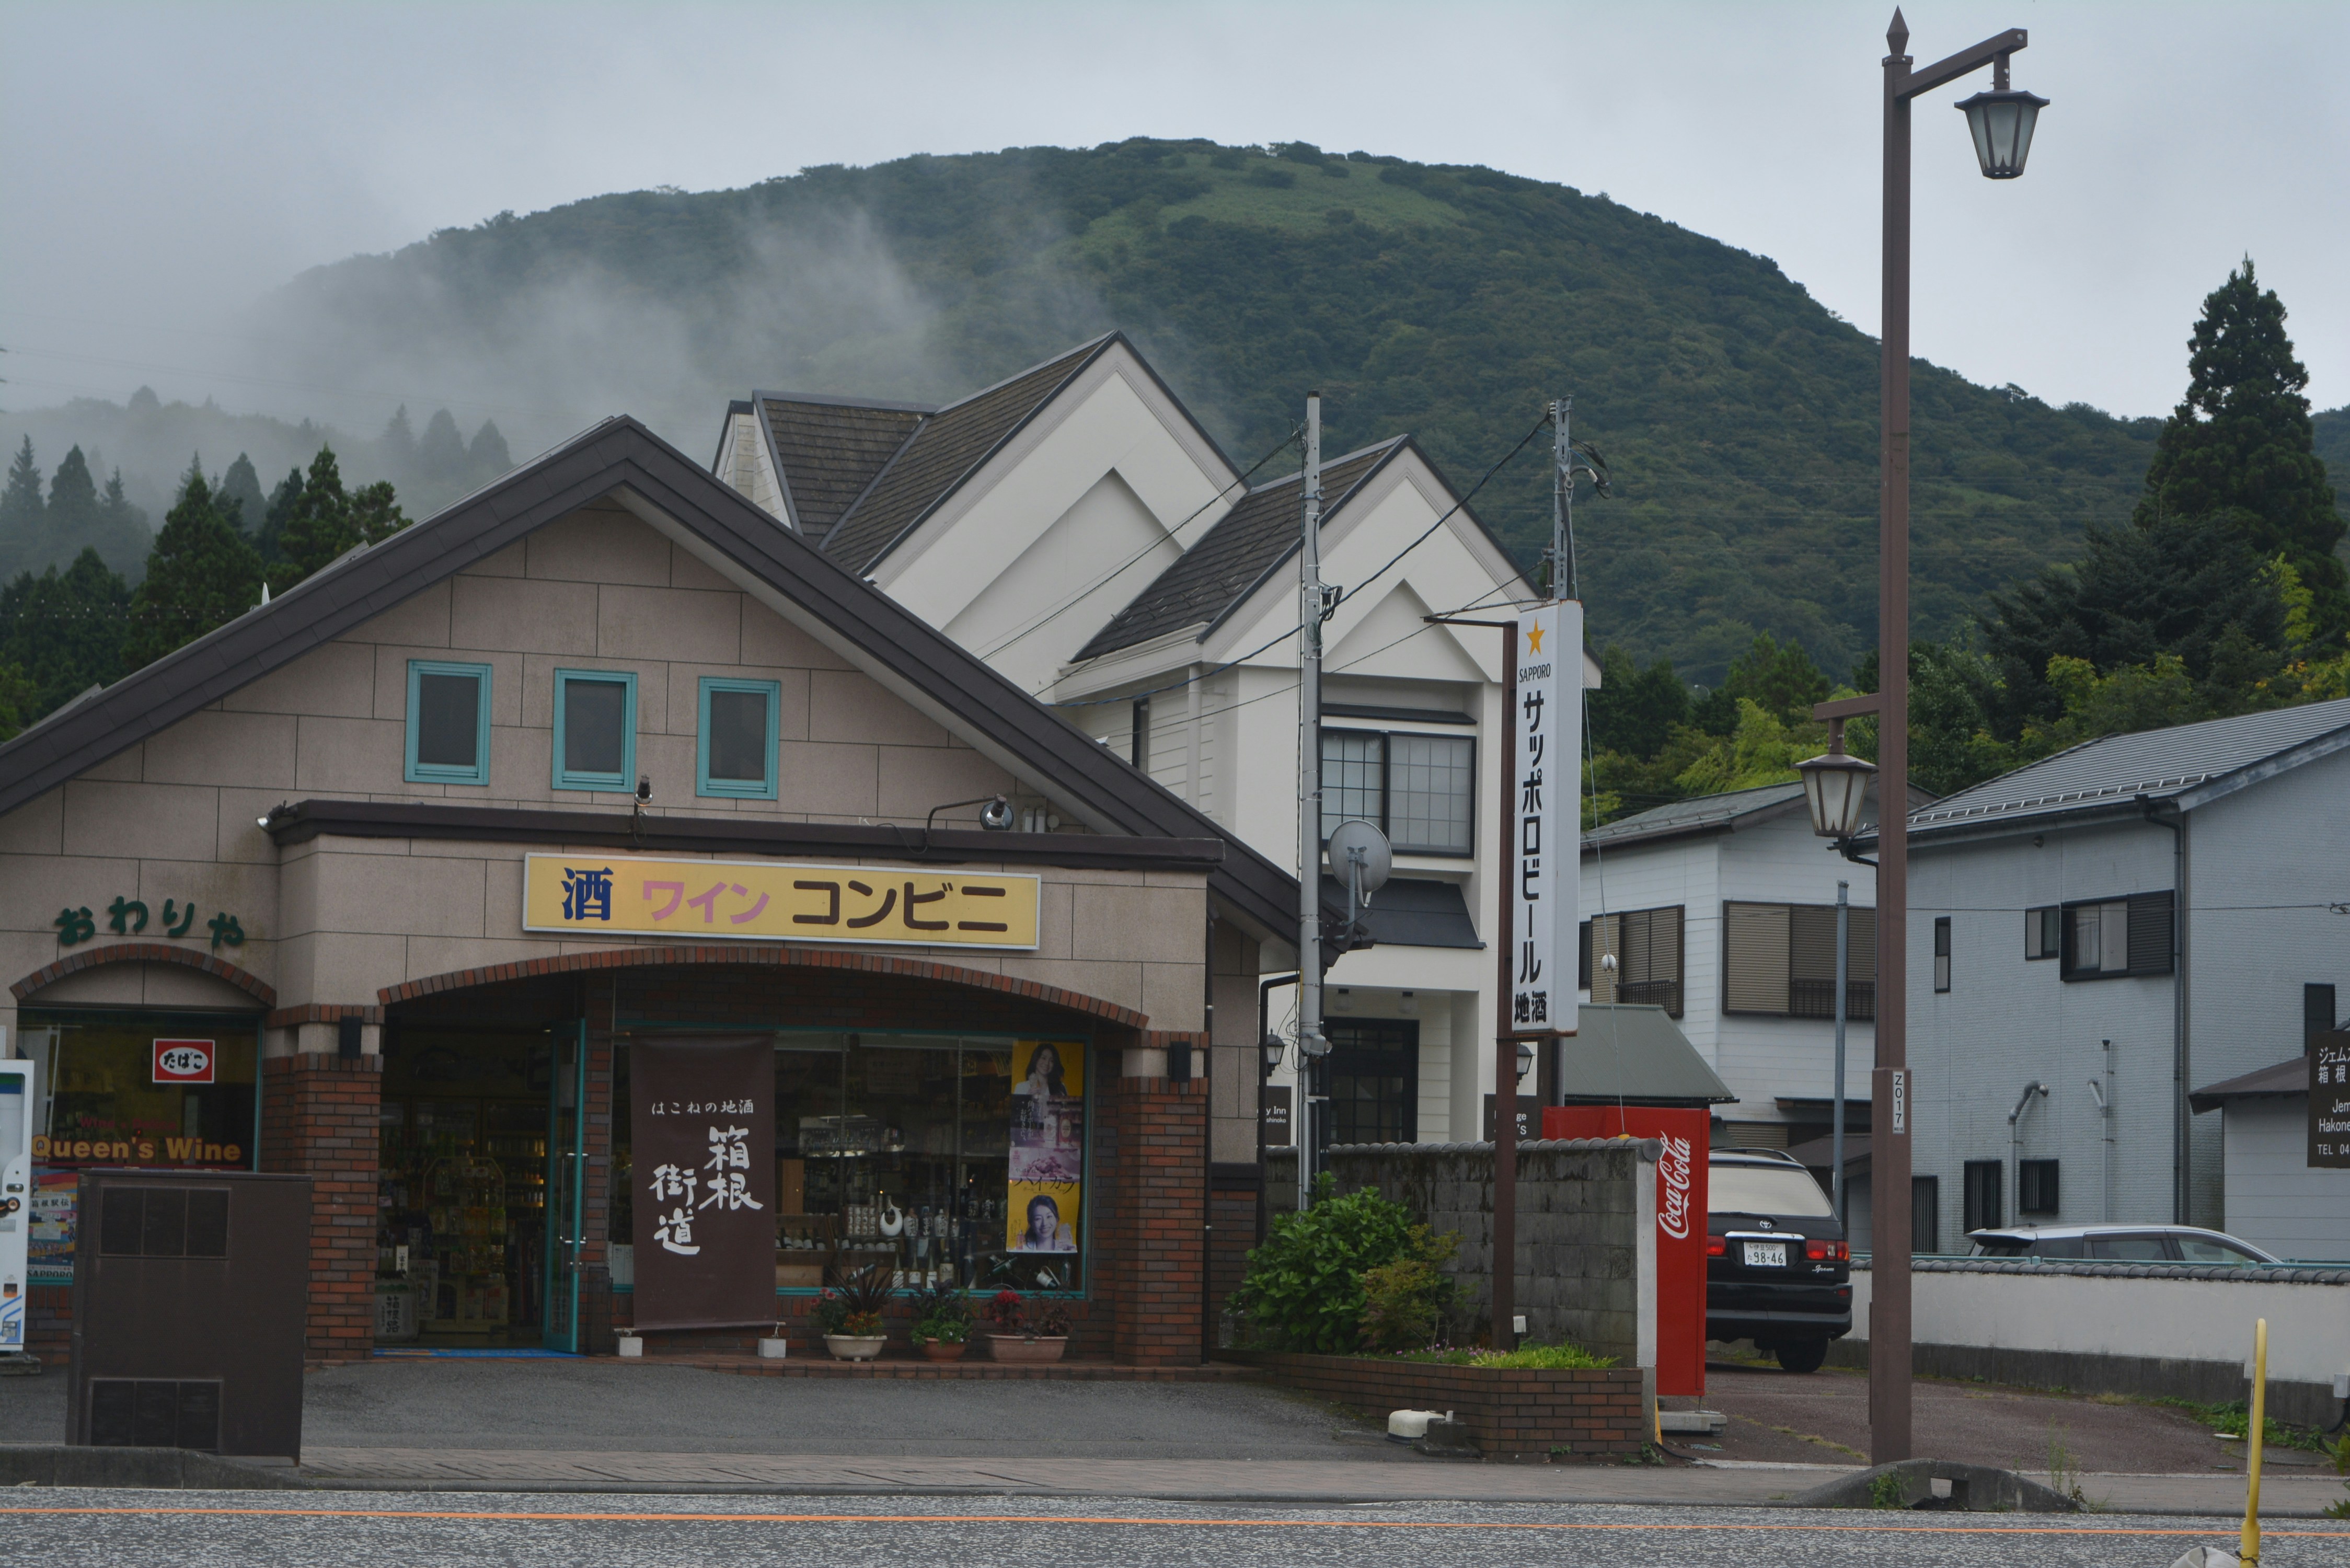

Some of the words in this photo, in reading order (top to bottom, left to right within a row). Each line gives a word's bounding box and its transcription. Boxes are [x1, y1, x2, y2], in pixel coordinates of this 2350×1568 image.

[1519, 662, 1551, 684] SAPPORO
[1519, 690, 1545, 985] サッポロビール
[560, 866, 614, 921] 酒
[642, 879, 770, 925] ワイン
[791, 879, 1009, 932] コンビニ
[55, 895, 245, 948] おわりや
[1514, 990, 1547, 1023] 地酒
[164, 1052, 203, 1069] たばこ
[652, 1099, 754, 1115] はこねの地酒
[1274, 1105, 1286, 1114] Inn
[31, 1134, 154, 1162] Queen's
[166, 1137, 241, 1162] Wine
[2318, 1144, 2333, 1155] TEL
[698, 1124, 764, 1210] 箱根
[1658, 1130, 1690, 1239] Coca-Cola
[649, 1163, 700, 1255] 街道
[1754, 1252, 1783, 1264] 98-46
